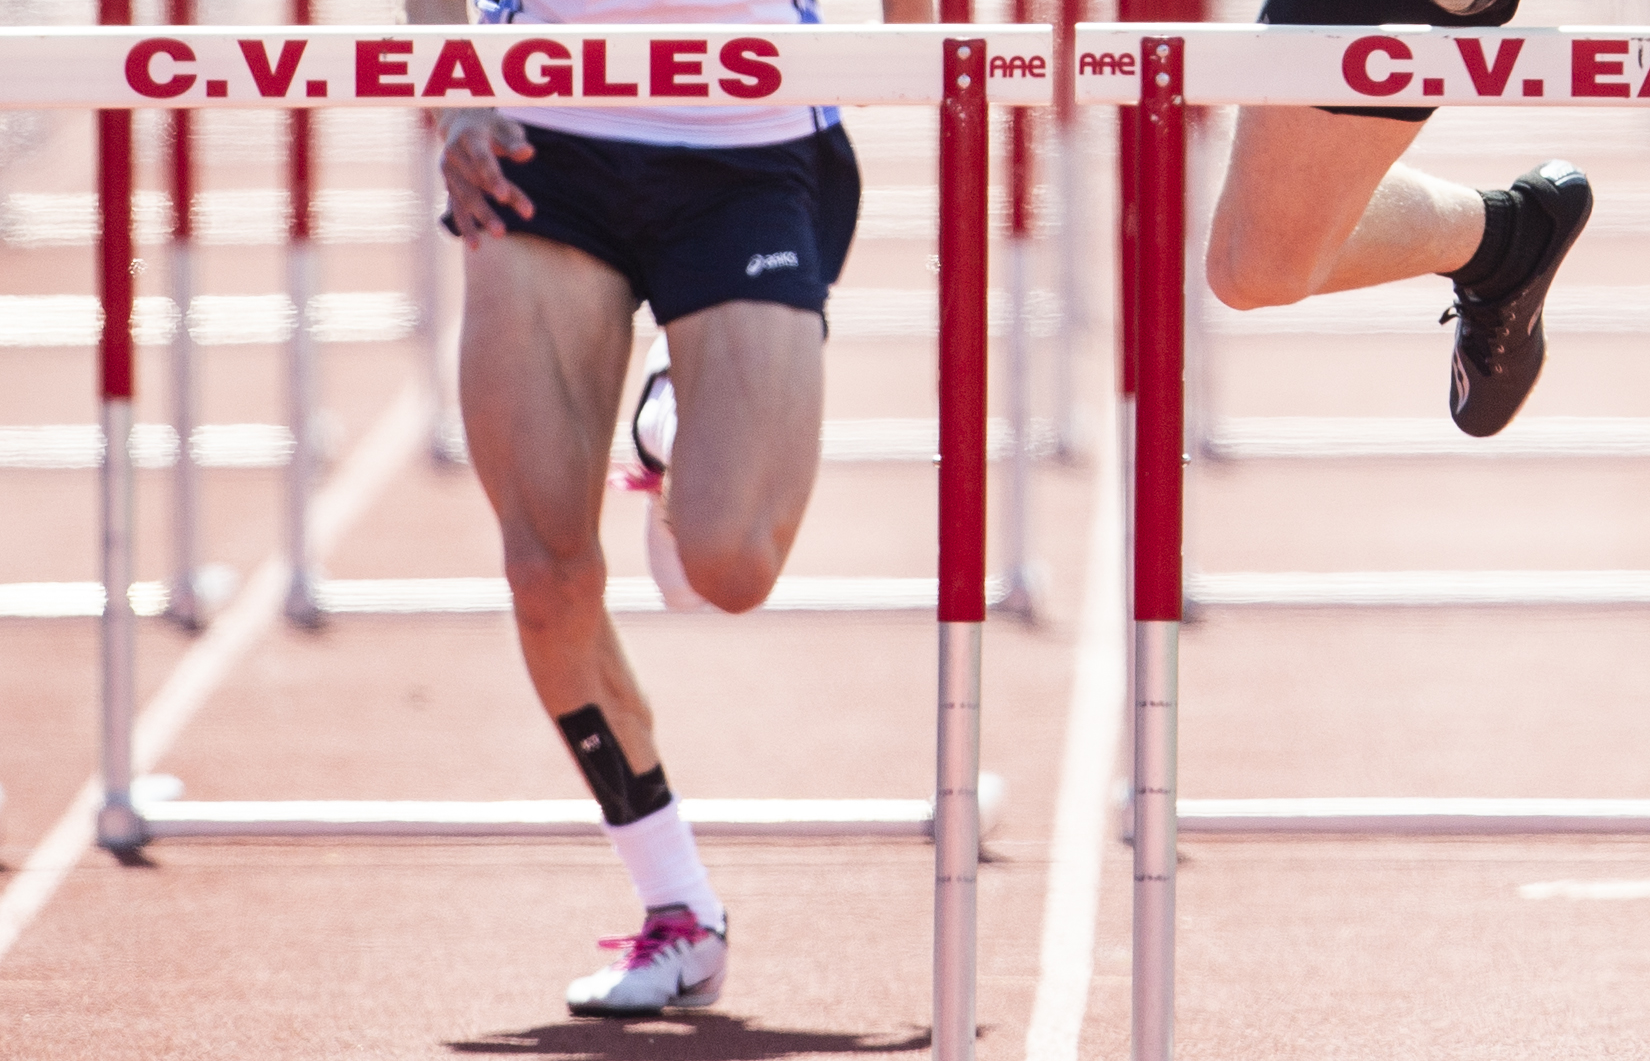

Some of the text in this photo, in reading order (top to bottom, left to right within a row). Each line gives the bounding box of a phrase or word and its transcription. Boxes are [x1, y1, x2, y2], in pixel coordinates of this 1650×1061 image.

[124, 37, 783, 100] C.V. EAGLES
[1341, 35, 1545, 98] C.V.
